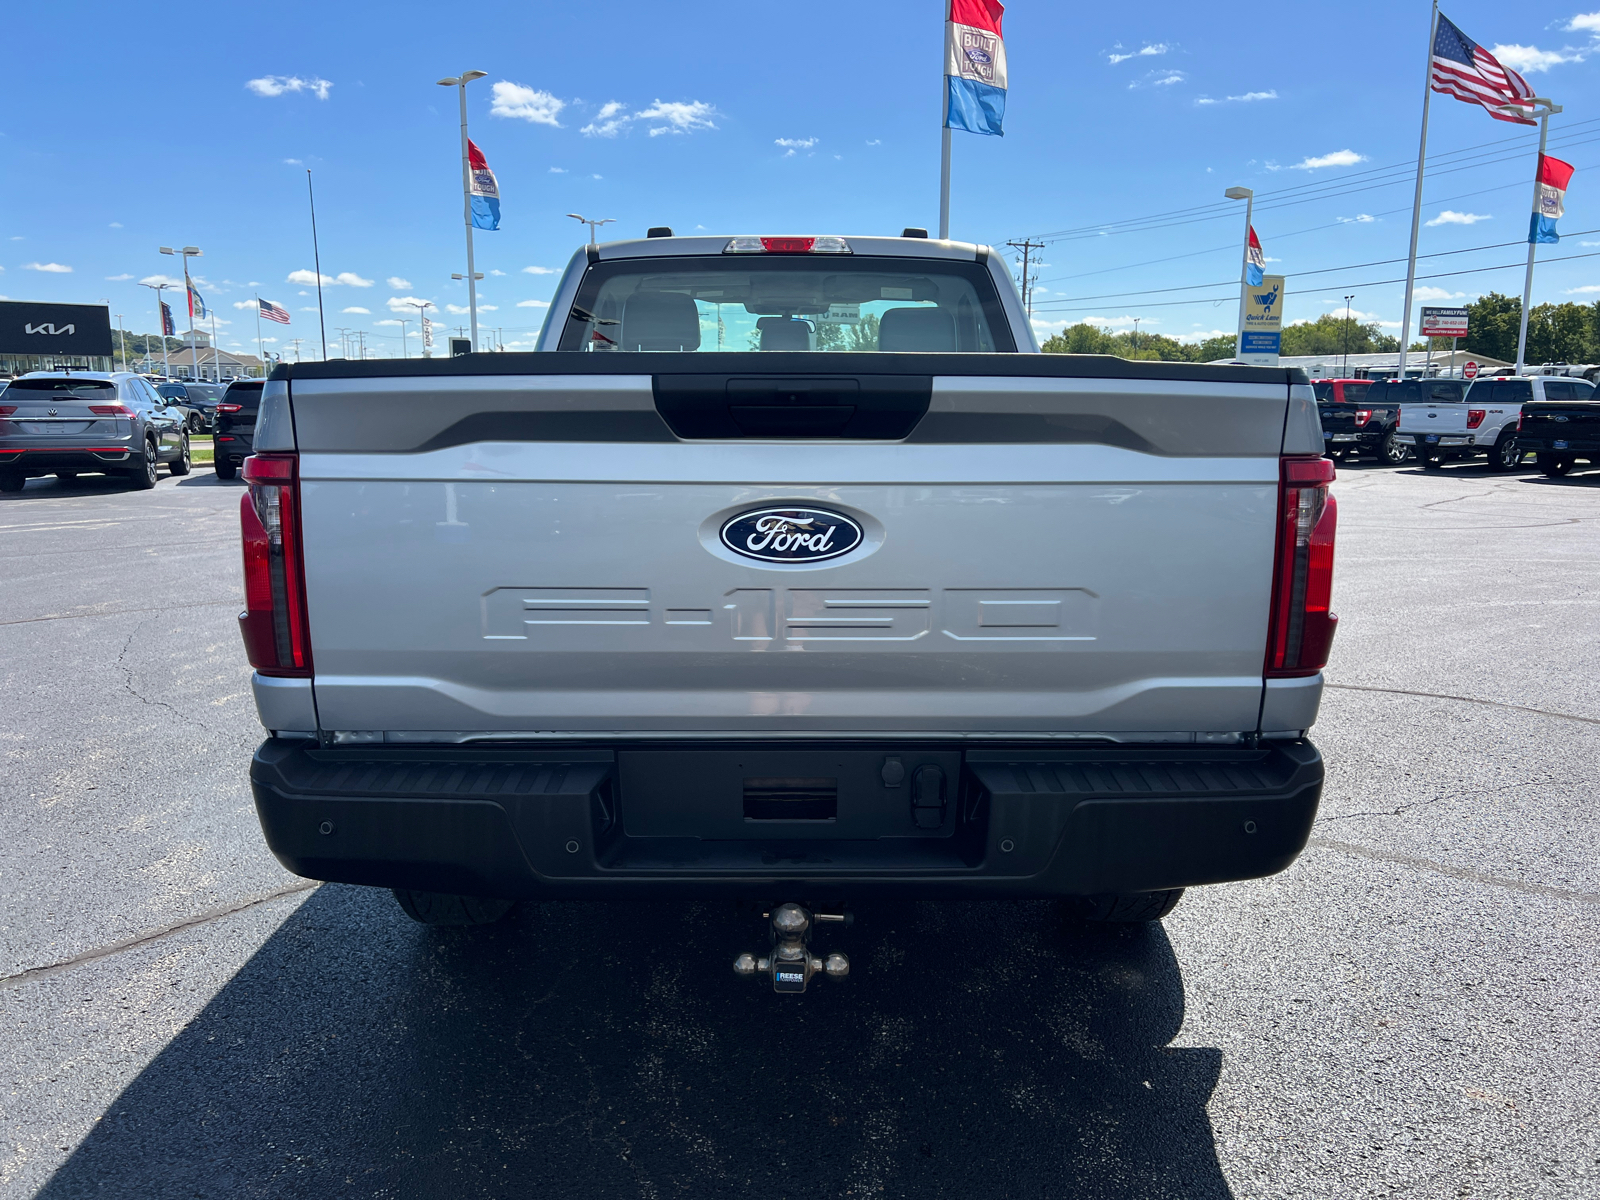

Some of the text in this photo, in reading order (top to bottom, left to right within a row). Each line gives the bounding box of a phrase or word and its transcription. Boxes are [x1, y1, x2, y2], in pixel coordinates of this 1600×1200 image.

[964, 34, 995, 51] BUILT
[968, 50, 988, 63] Ford
[474, 183, 495, 193] TOUGH
[1246, 313, 1265, 321] Quick
[747, 515, 833, 552] Ford
[480, 586, 1100, 641] F-150
